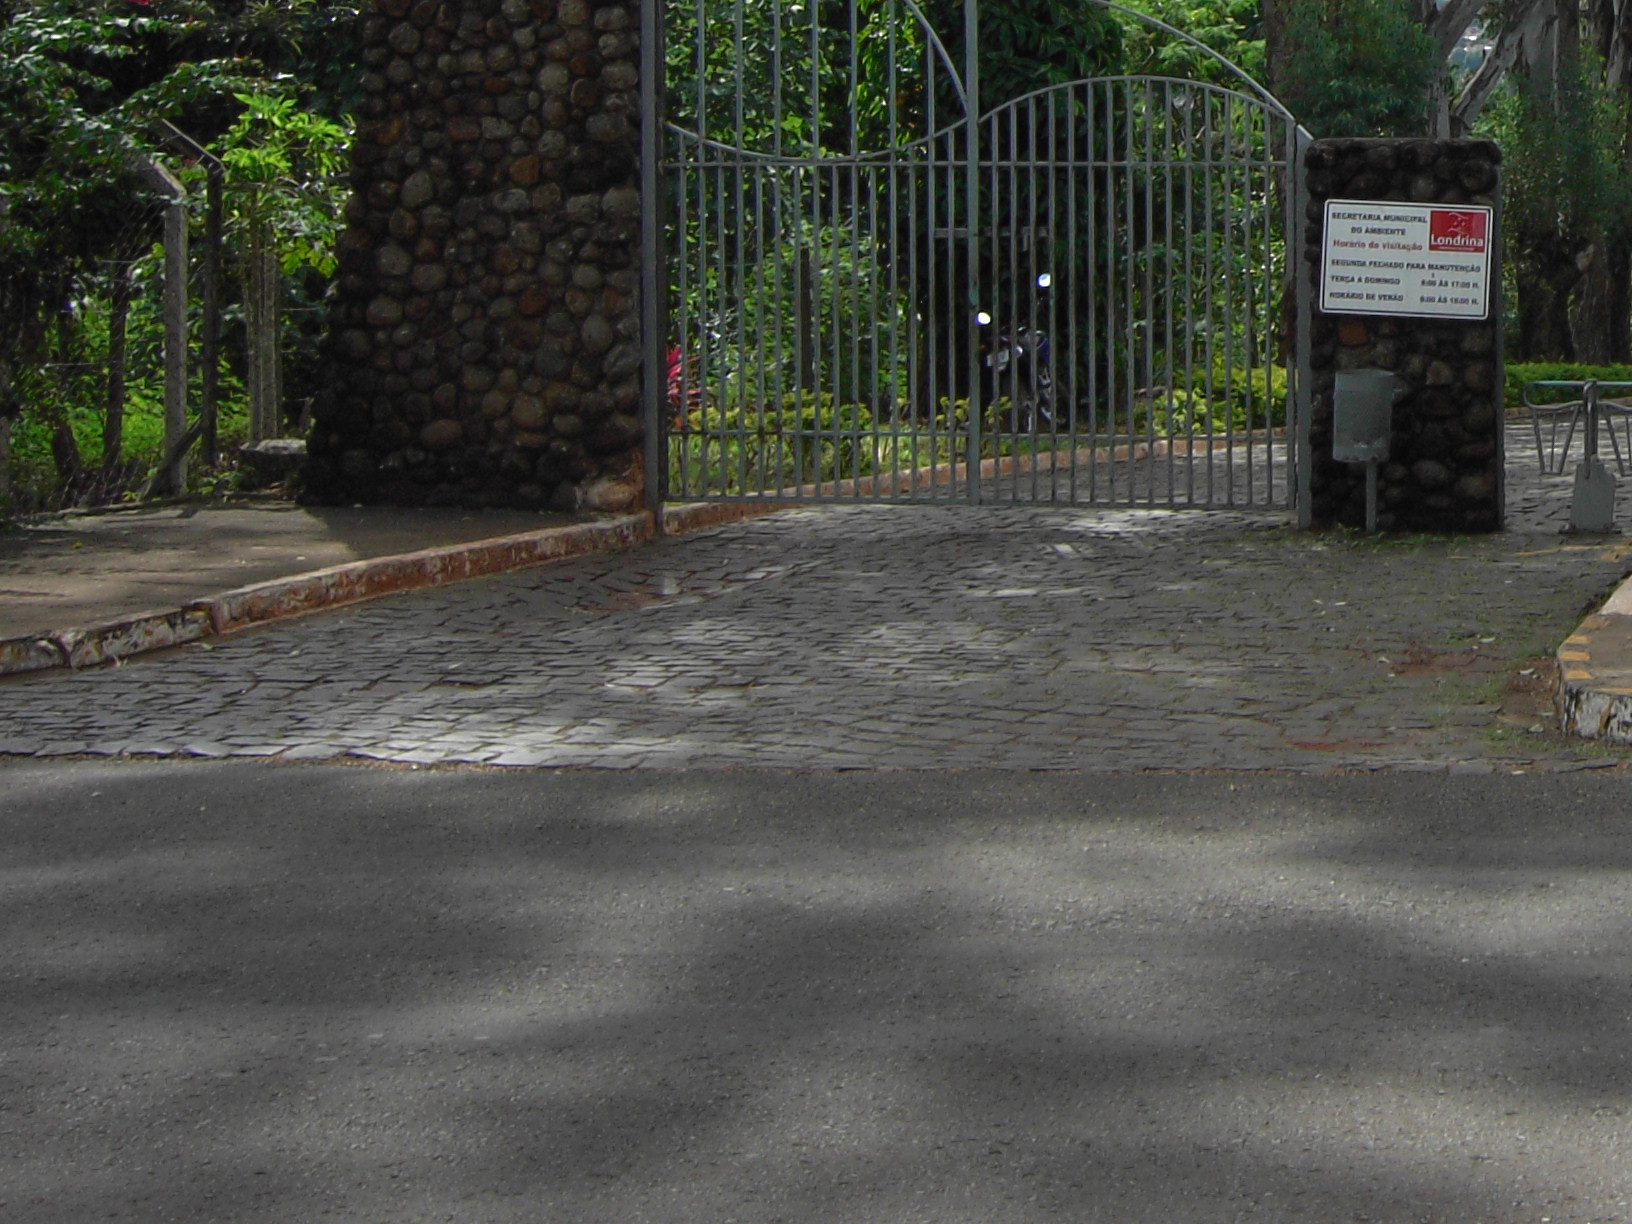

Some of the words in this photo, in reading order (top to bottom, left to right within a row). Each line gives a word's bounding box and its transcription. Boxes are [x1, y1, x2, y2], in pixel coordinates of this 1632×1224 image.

[1331, 212, 1382, 222] SECRETARIA
[1383, 214, 1428, 223] MUNICIPAL
[1364, 226, 1406, 236] AMBIENTE
[1431, 233, 1483, 247] Londrina
